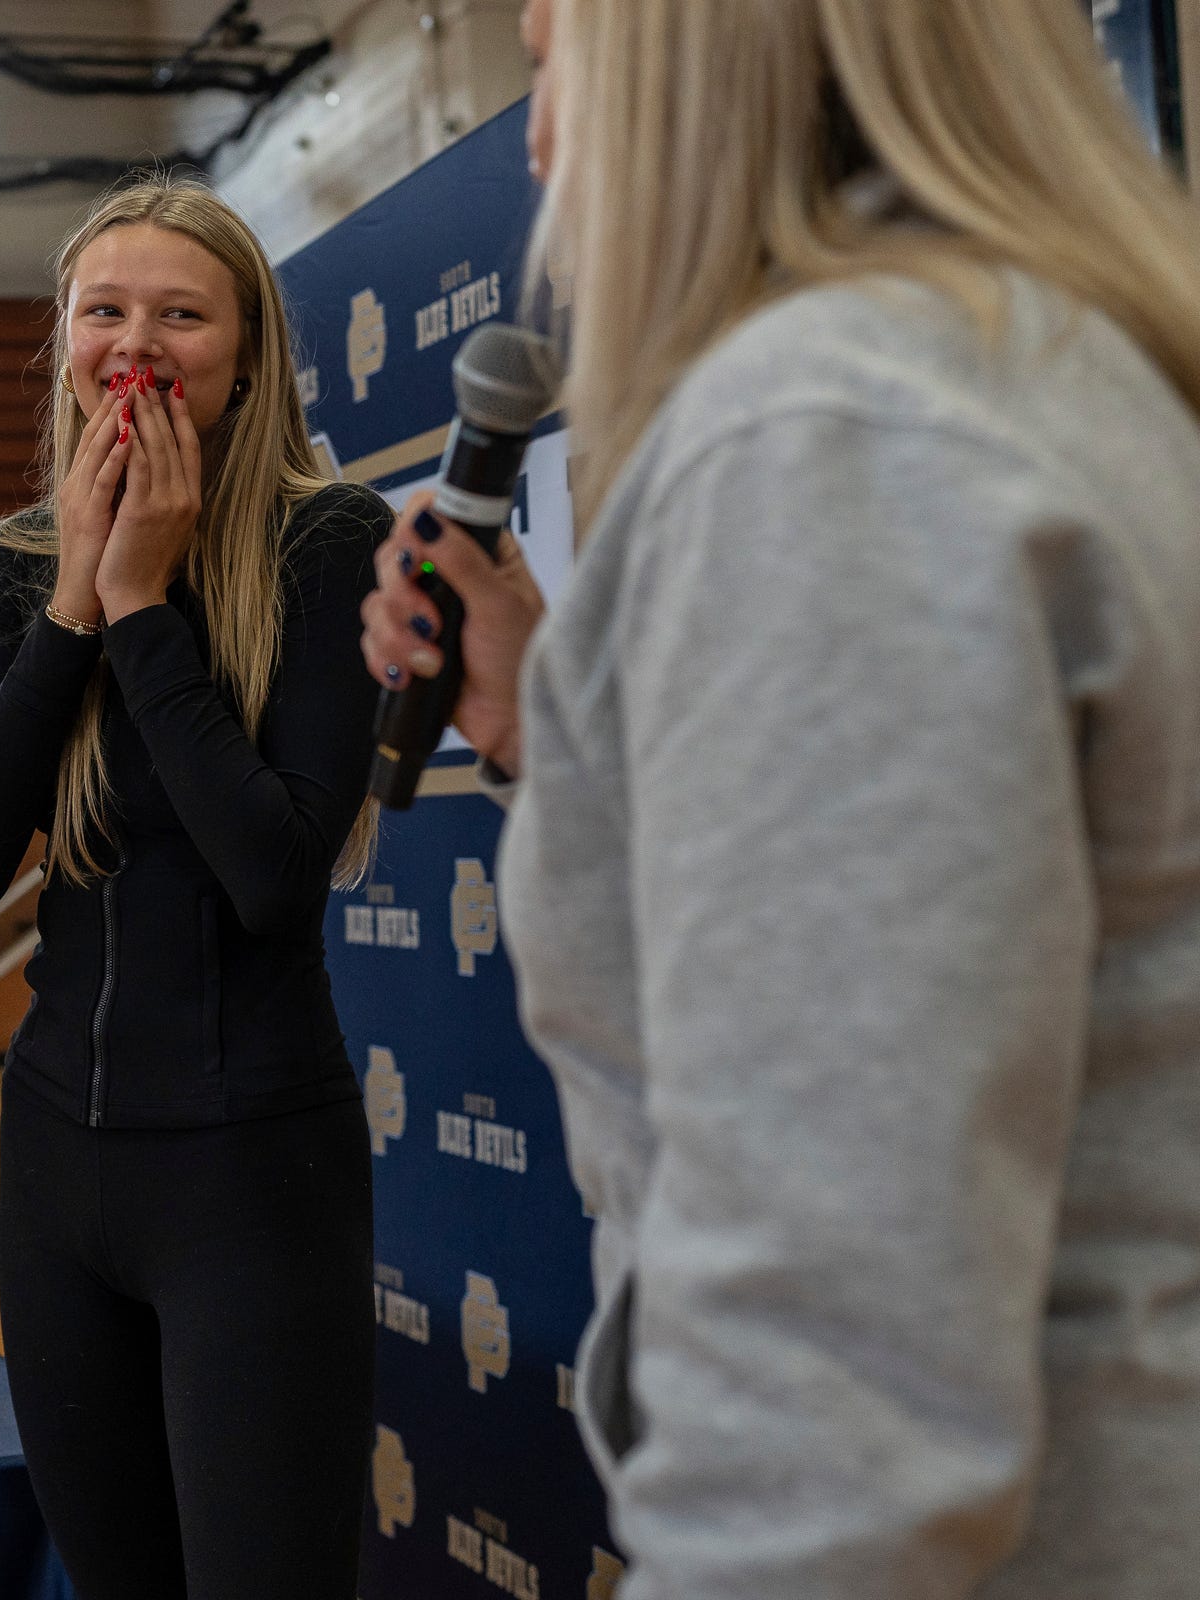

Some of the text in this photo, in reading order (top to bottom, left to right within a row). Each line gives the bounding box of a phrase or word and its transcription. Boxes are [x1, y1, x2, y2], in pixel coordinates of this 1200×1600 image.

[451, 271, 501, 333] DEVILS
[376, 907, 420, 949] DEVILS
[474, 1119, 527, 1174] DEVILS
[385, 1289, 430, 1346] DEVILS
[485, 1537, 540, 1600] DEVILS
